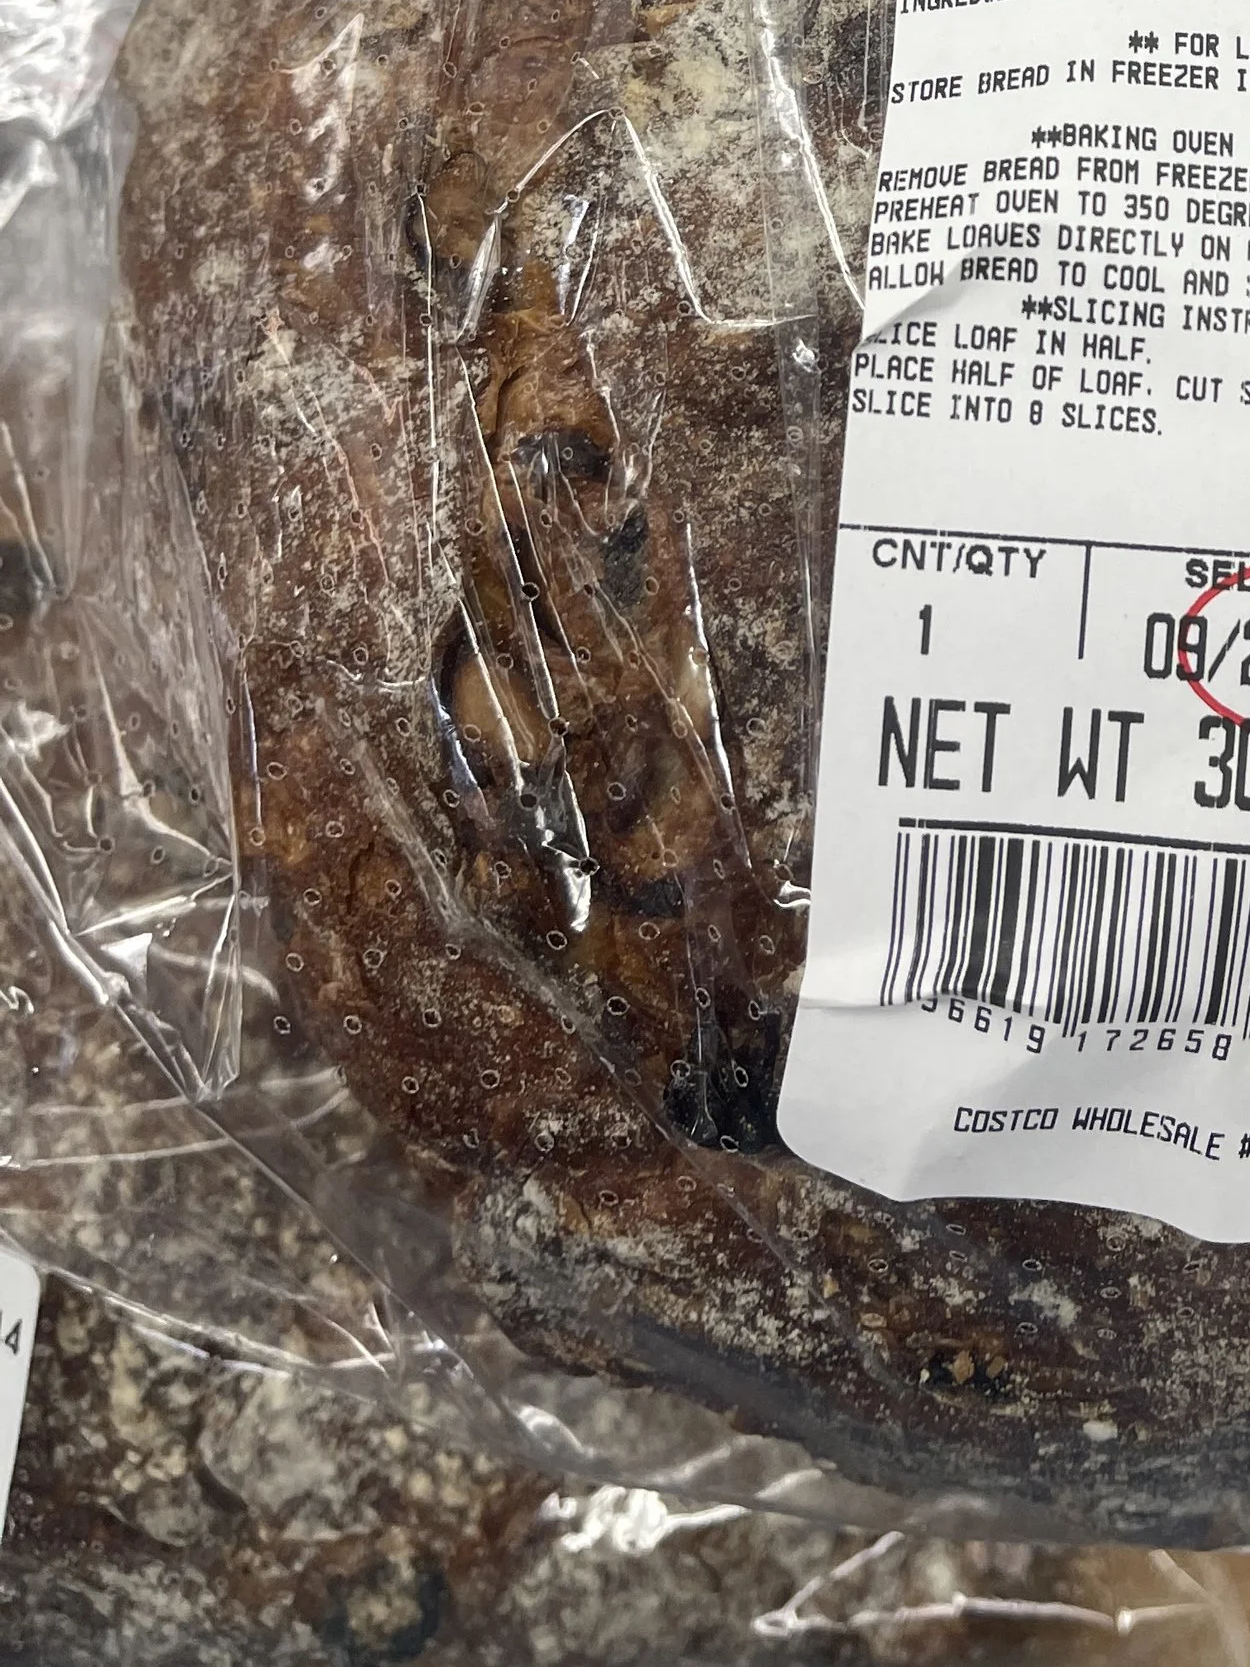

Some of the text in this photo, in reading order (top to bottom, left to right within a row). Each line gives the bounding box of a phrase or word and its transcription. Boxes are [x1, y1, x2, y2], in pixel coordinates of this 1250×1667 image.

[1174, 31, 1220, 59] FOR
[890, 75, 964, 105] STORE
[977, 64, 1050, 95] BREAD
[1066, 58, 1095, 83] IN
[1111, 59, 1219, 91] FREEZER
[1172, 129, 1234, 158] OVEN
[878, 163, 969, 193] REMOVE
[983, 155, 1060, 183] BREAD
[1077, 155, 1140, 186] FROM
[873, 192, 980, 225] PREHEAT
[995, 188, 1059, 214] OVEN
[1077, 190, 1107, 217] TO
[1123, 193, 1170, 222] 350
[870, 228, 932, 257] BAKE
[946, 221, 1042, 251] LOAVES
[1057, 223, 1184, 258] DIRECTLY
[1200, 233, 1231, 263] ON
[868, 259, 945, 291] ALLOW
[959, 255, 1039, 284] BREAD
[1057, 259, 1087, 288] TO
[1103, 263, 1166, 294] COOL
[1182, 268, 1230, 298] AND
[954, 323, 1018, 353] LOAF
[1035, 328, 1067, 357] IN
[1082, 332, 1152, 365] HALF.
[854, 352, 935, 383] PLACE
[951, 358, 1016, 388] HALF
[1031, 364, 1064, 391] OF
[1175, 374, 1224, 403] CUT
[852, 389, 1163, 436] SLICE INTO SLICES.
[873, 539, 1046, 578] CNT/QTY
[918, 604, 933, 655] 1
[877, 695, 1011, 793] NET
[1056, 706, 1145, 803] WT
[954, 1107, 1059, 1133] COSTCO
[1072, 1107, 1224, 1162] WHOLESALE
